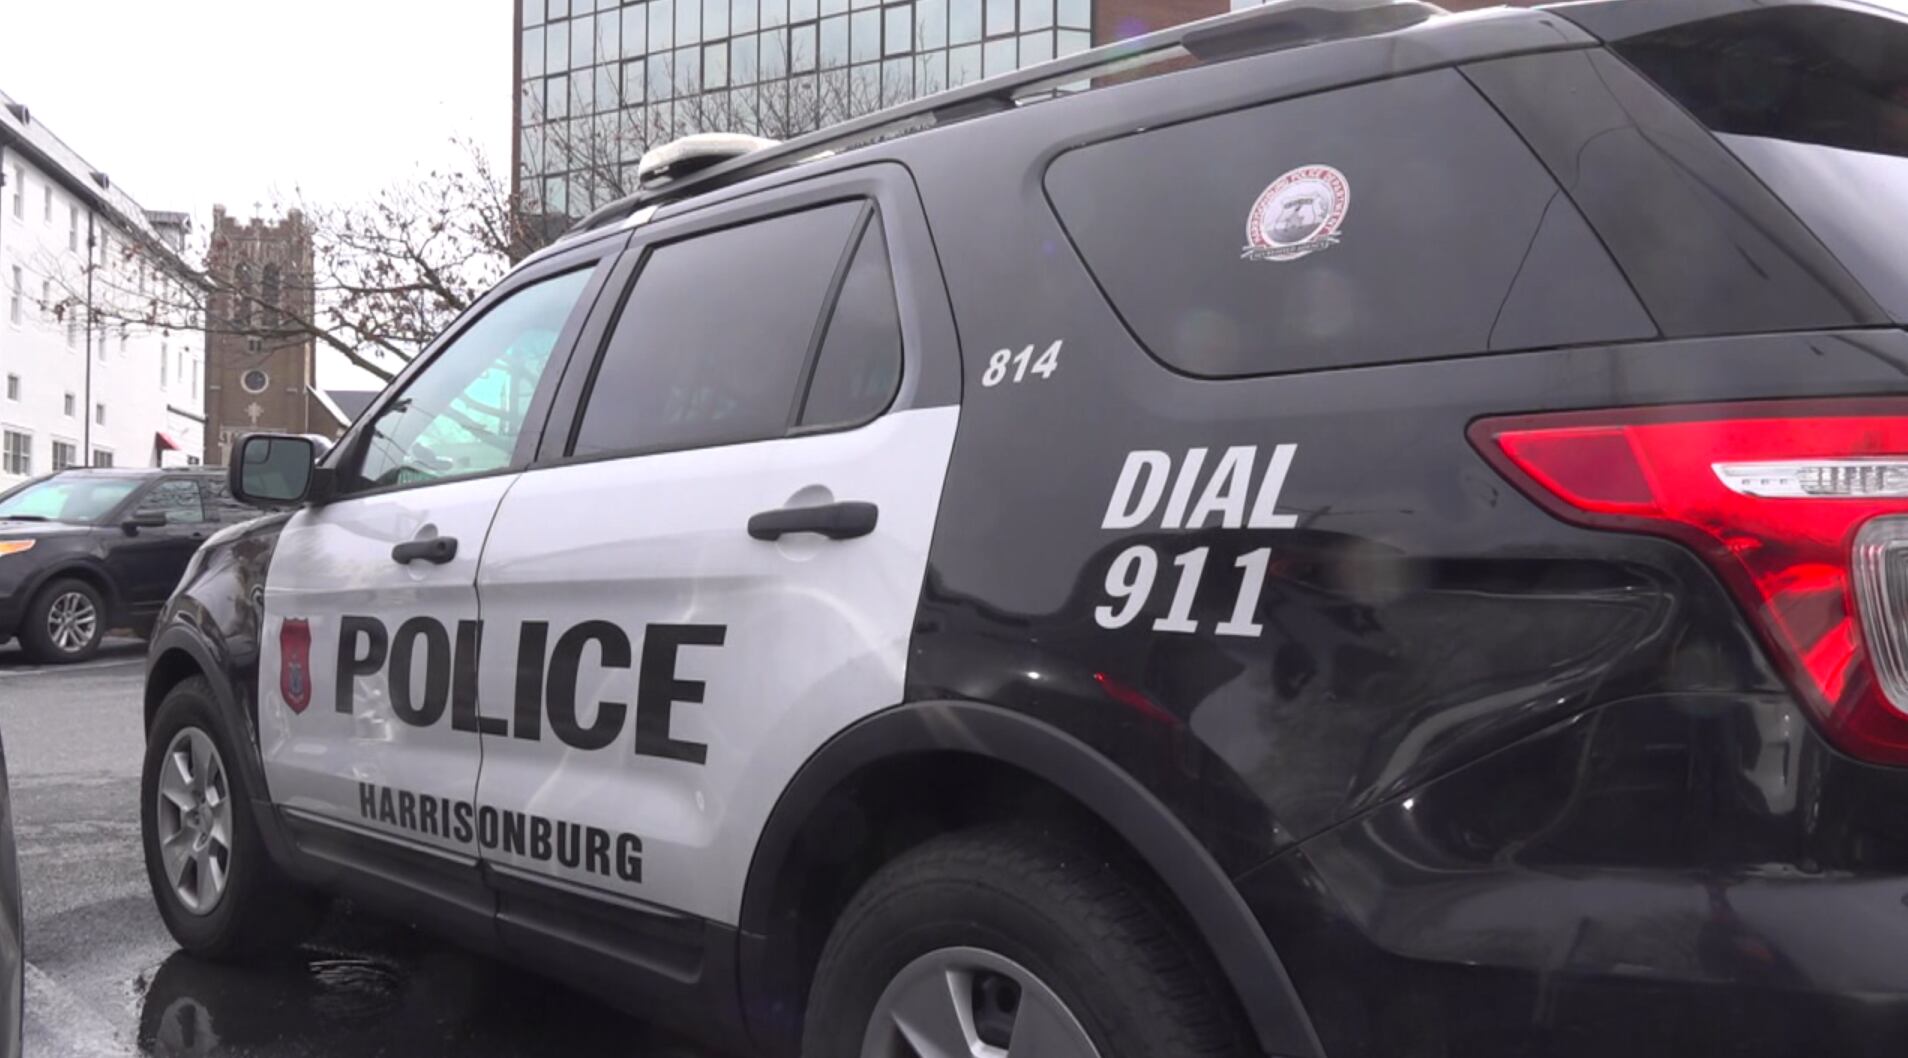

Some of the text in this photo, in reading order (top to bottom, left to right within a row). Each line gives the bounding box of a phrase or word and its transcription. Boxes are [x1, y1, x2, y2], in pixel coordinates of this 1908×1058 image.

[982, 339, 1062, 387] 814
[1102, 443, 1299, 529] DIAL
[1095, 545, 1271, 637] 911
[335, 614, 727, 765] POLICE
[359, 782, 643, 884] HARRISONBURG
